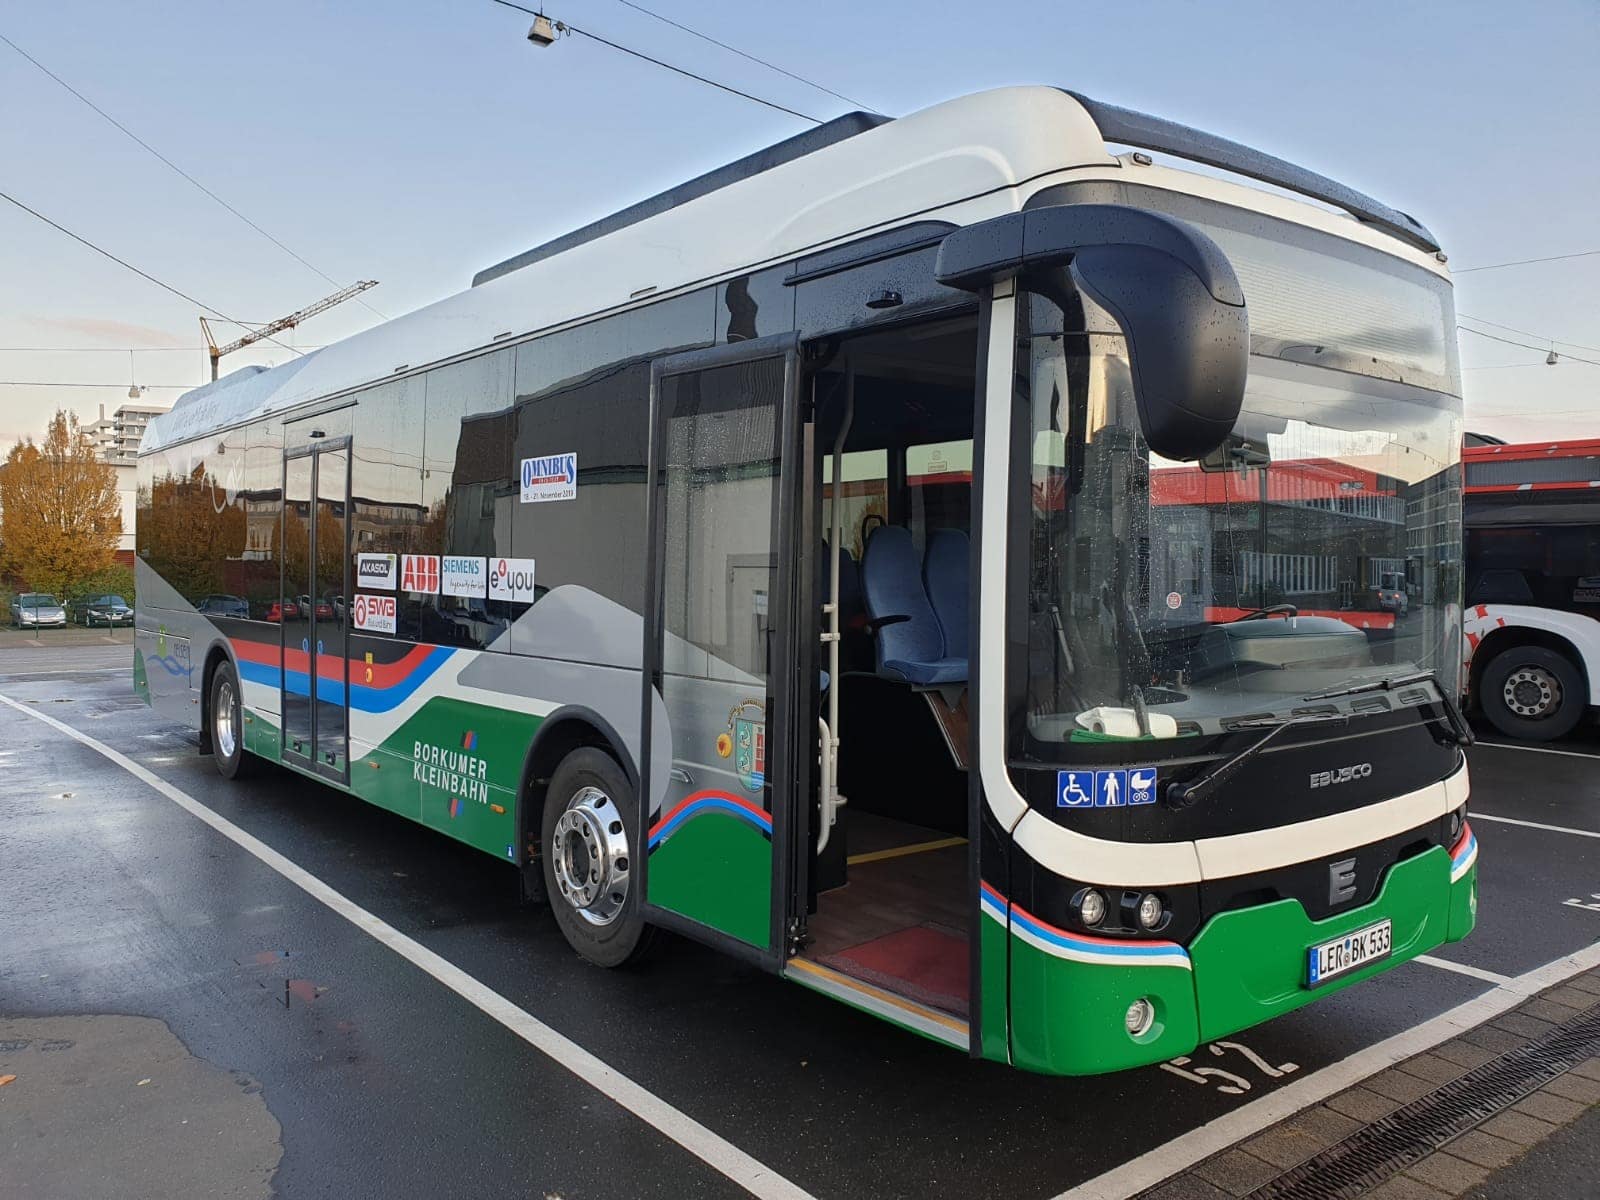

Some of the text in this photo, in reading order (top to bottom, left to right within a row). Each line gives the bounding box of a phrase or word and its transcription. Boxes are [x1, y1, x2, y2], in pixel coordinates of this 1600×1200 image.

[523, 455, 575, 488] OMNIBUS
[361, 563, 389, 574] AKASOL
[402, 555, 438, 593] ABB
[443, 559, 480, 574] SIEMENS
[368, 597, 395, 617] SWB
[414, 741, 487, 780] BORKUMER
[1310, 763, 1372, 789] EBUSCO
[414, 761, 488, 804] KLEINBAHN
[1320, 926, 1390, 975] LER BK 533
